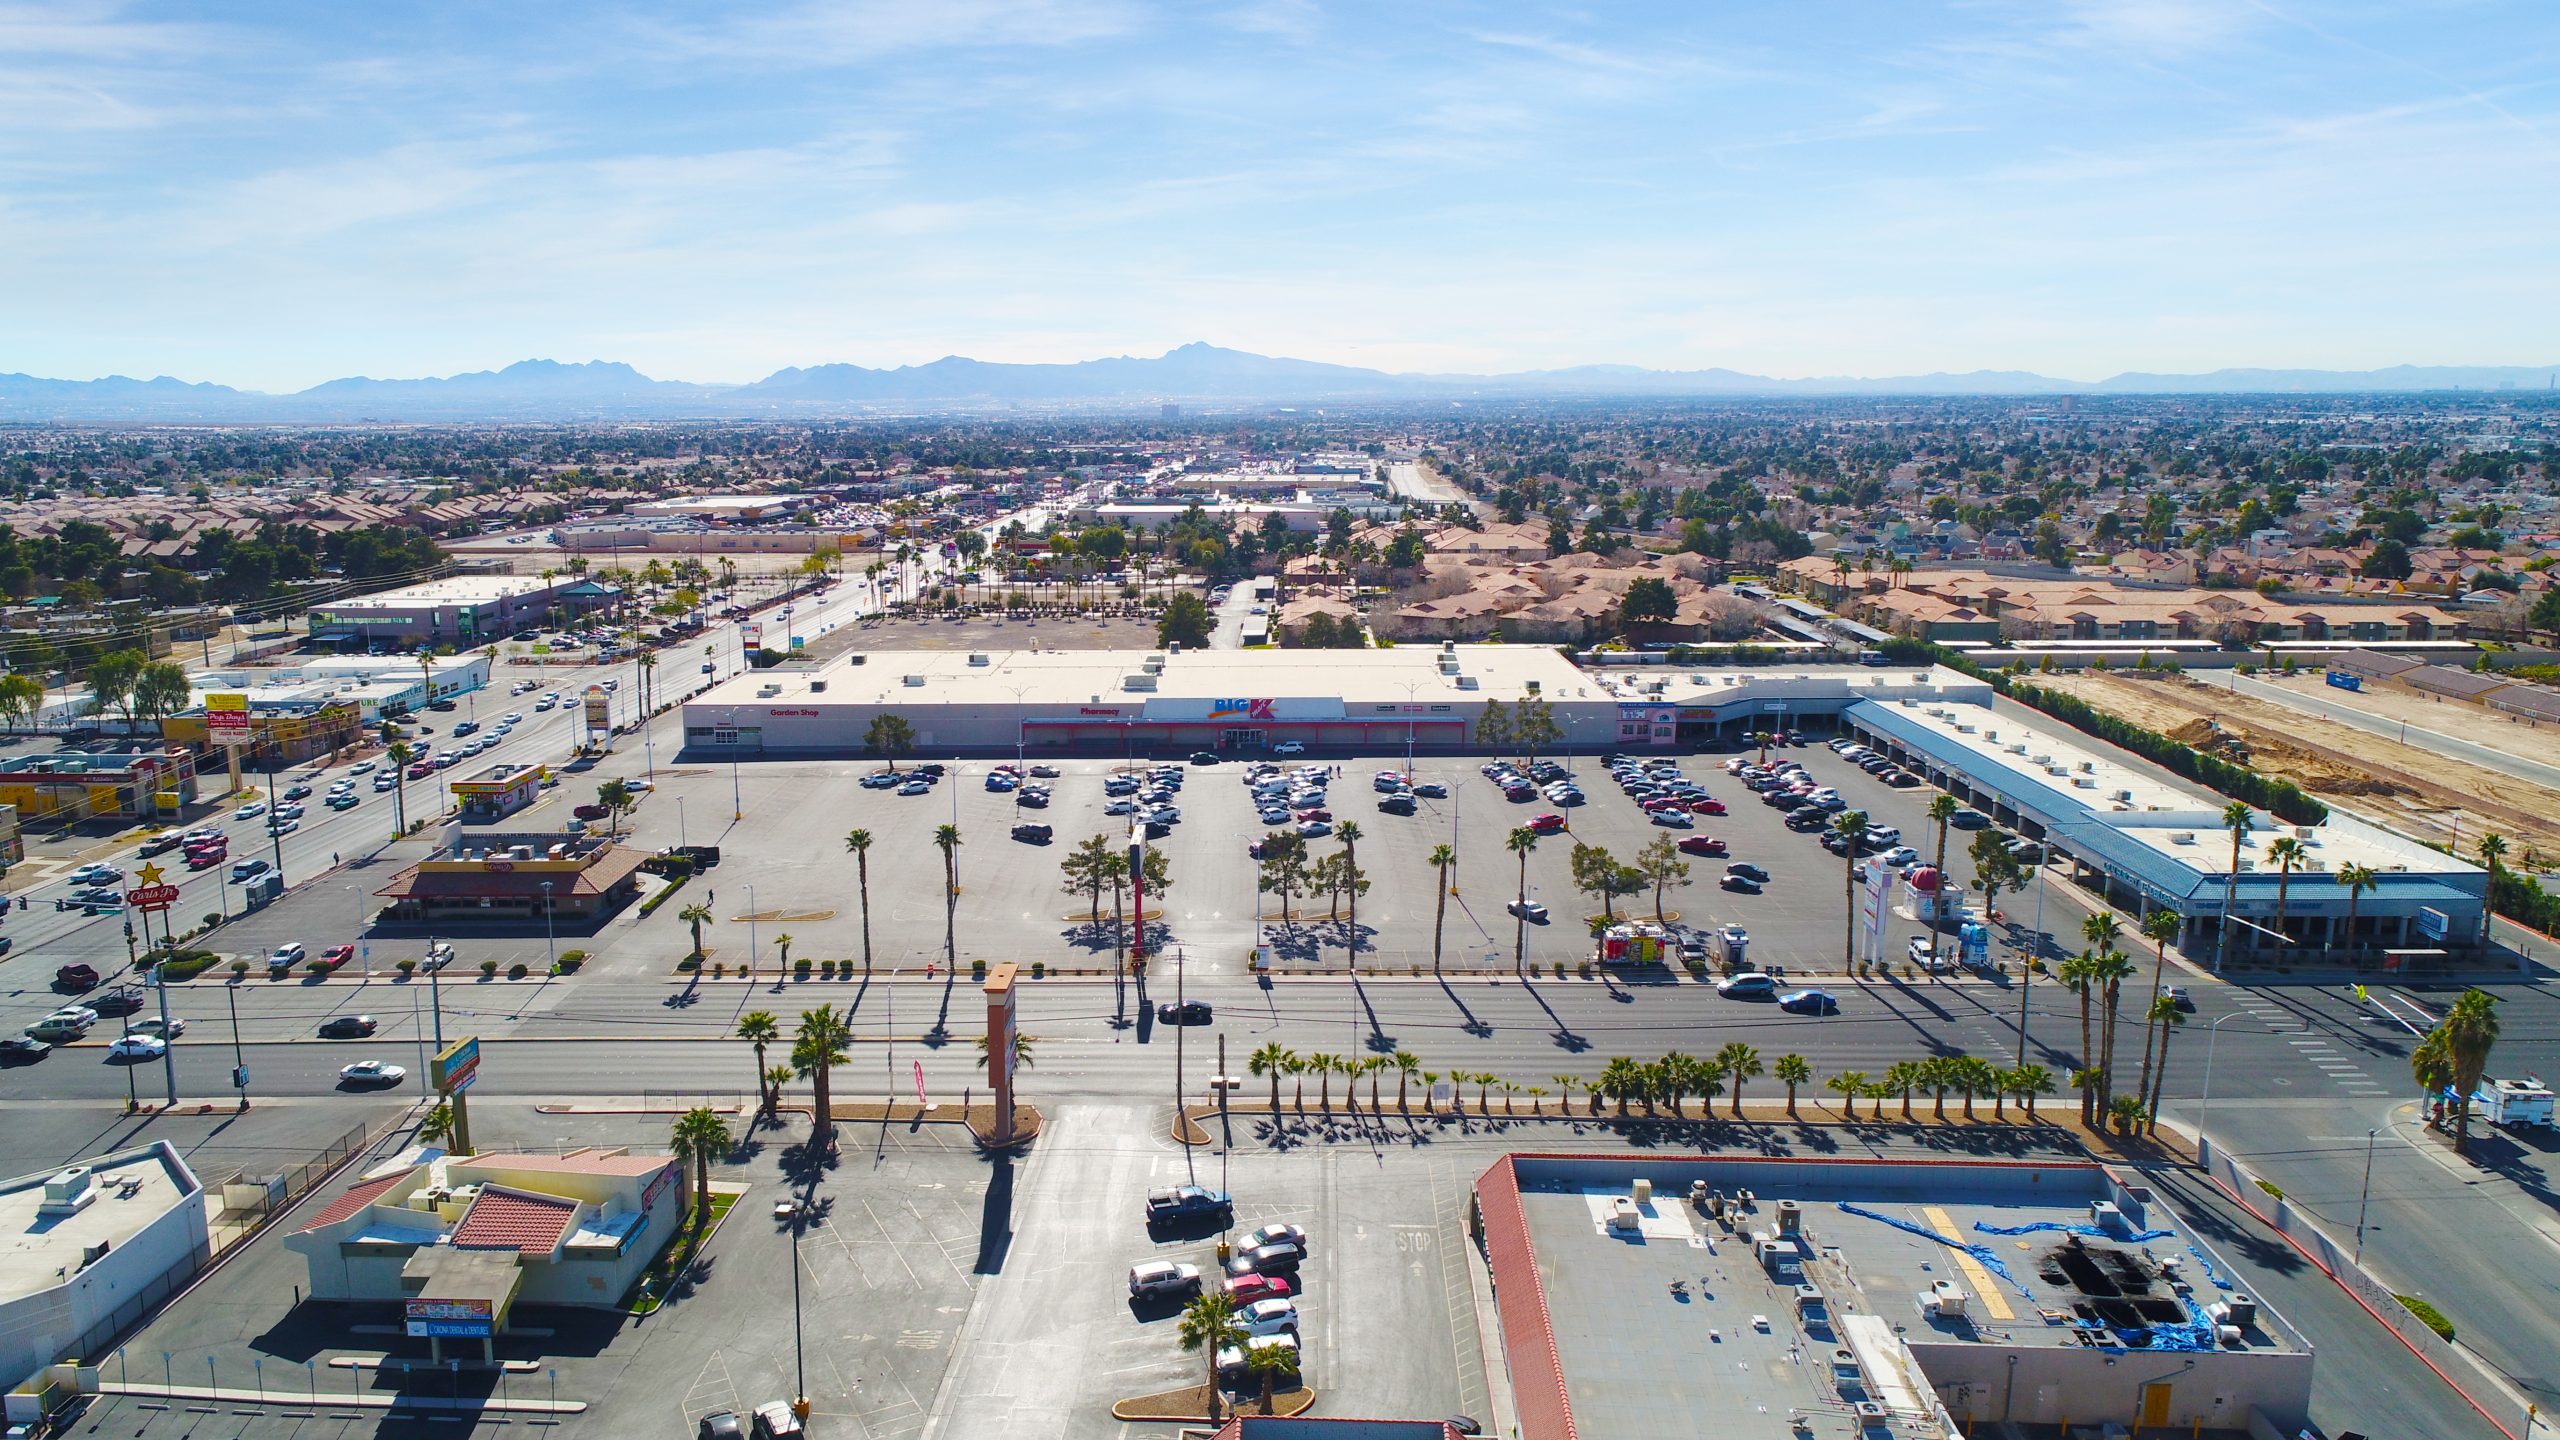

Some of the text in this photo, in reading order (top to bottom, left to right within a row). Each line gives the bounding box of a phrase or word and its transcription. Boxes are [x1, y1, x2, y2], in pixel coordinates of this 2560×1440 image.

[800, 709, 819, 717] Shop
[1080, 707, 1120, 716] Pharmacy
[1214, 698, 1275, 719] BIG K
[225, 713, 246, 722] Boys
[1399, 1231, 1431, 1253] STOP
[449, 1325, 464, 1334] DENTAL
[468, 1326, 489, 1335] DENTURES
